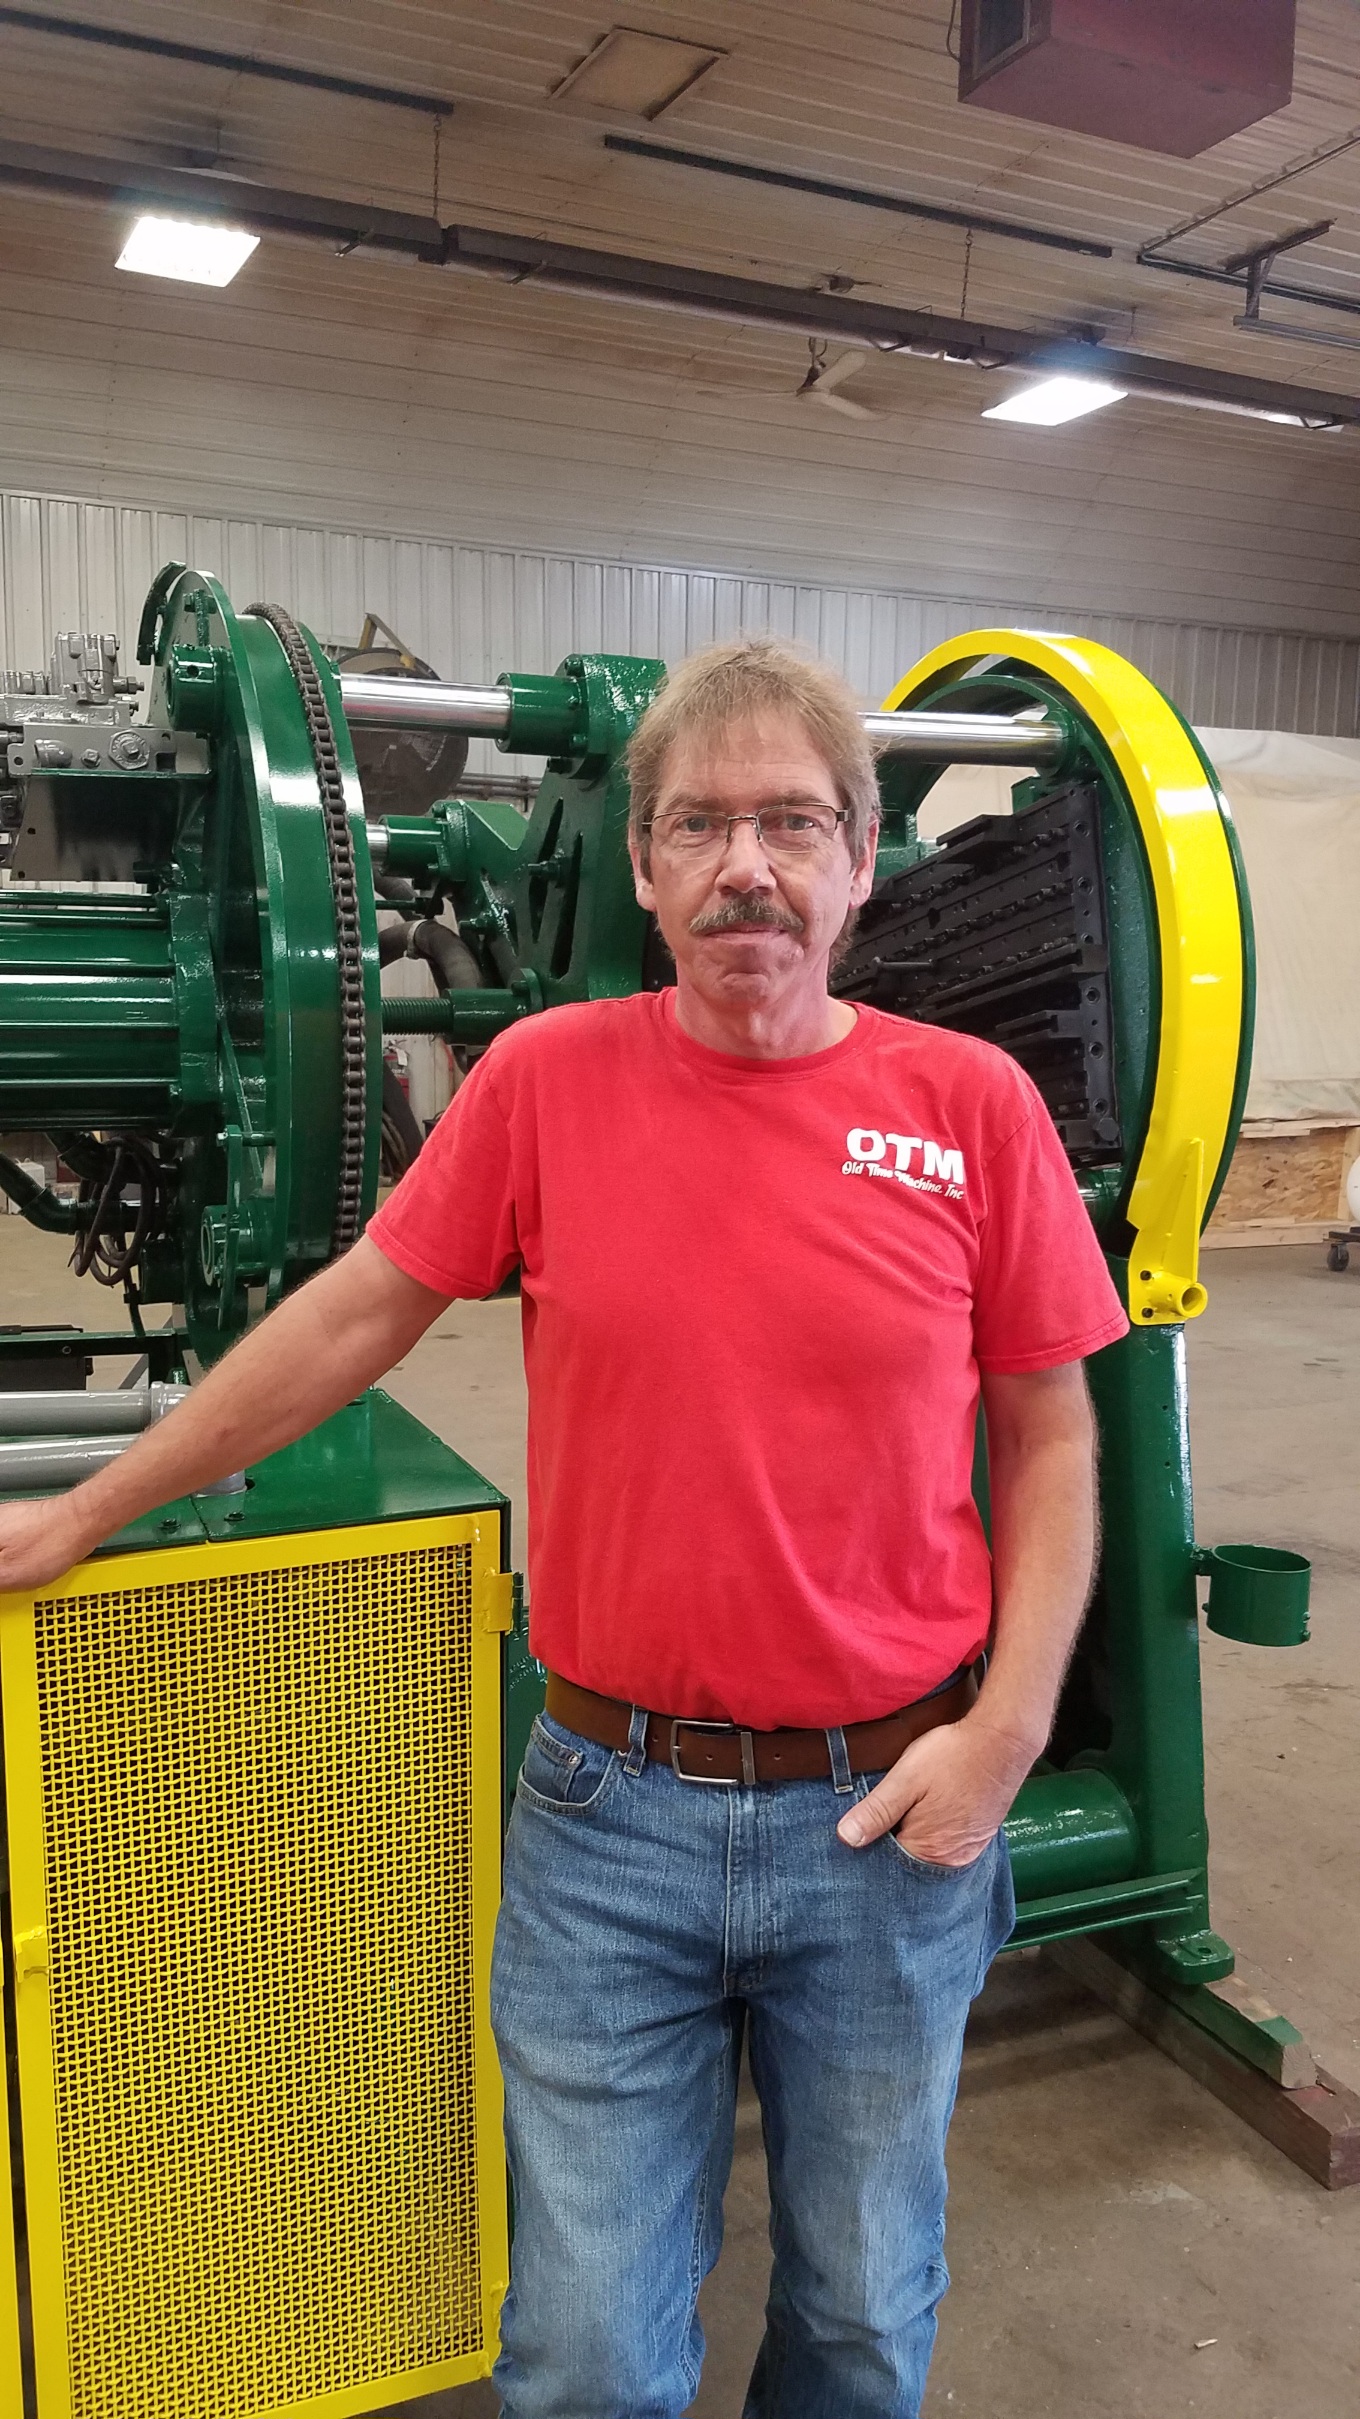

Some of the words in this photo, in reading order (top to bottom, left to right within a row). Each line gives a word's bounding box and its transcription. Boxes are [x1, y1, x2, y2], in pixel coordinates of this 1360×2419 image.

[846, 1127, 964, 1185] OTM
[841, 1161, 863, 1175] Old
[866, 1163, 893, 1178] Time
[943, 1184, 964, 1200] Inc
